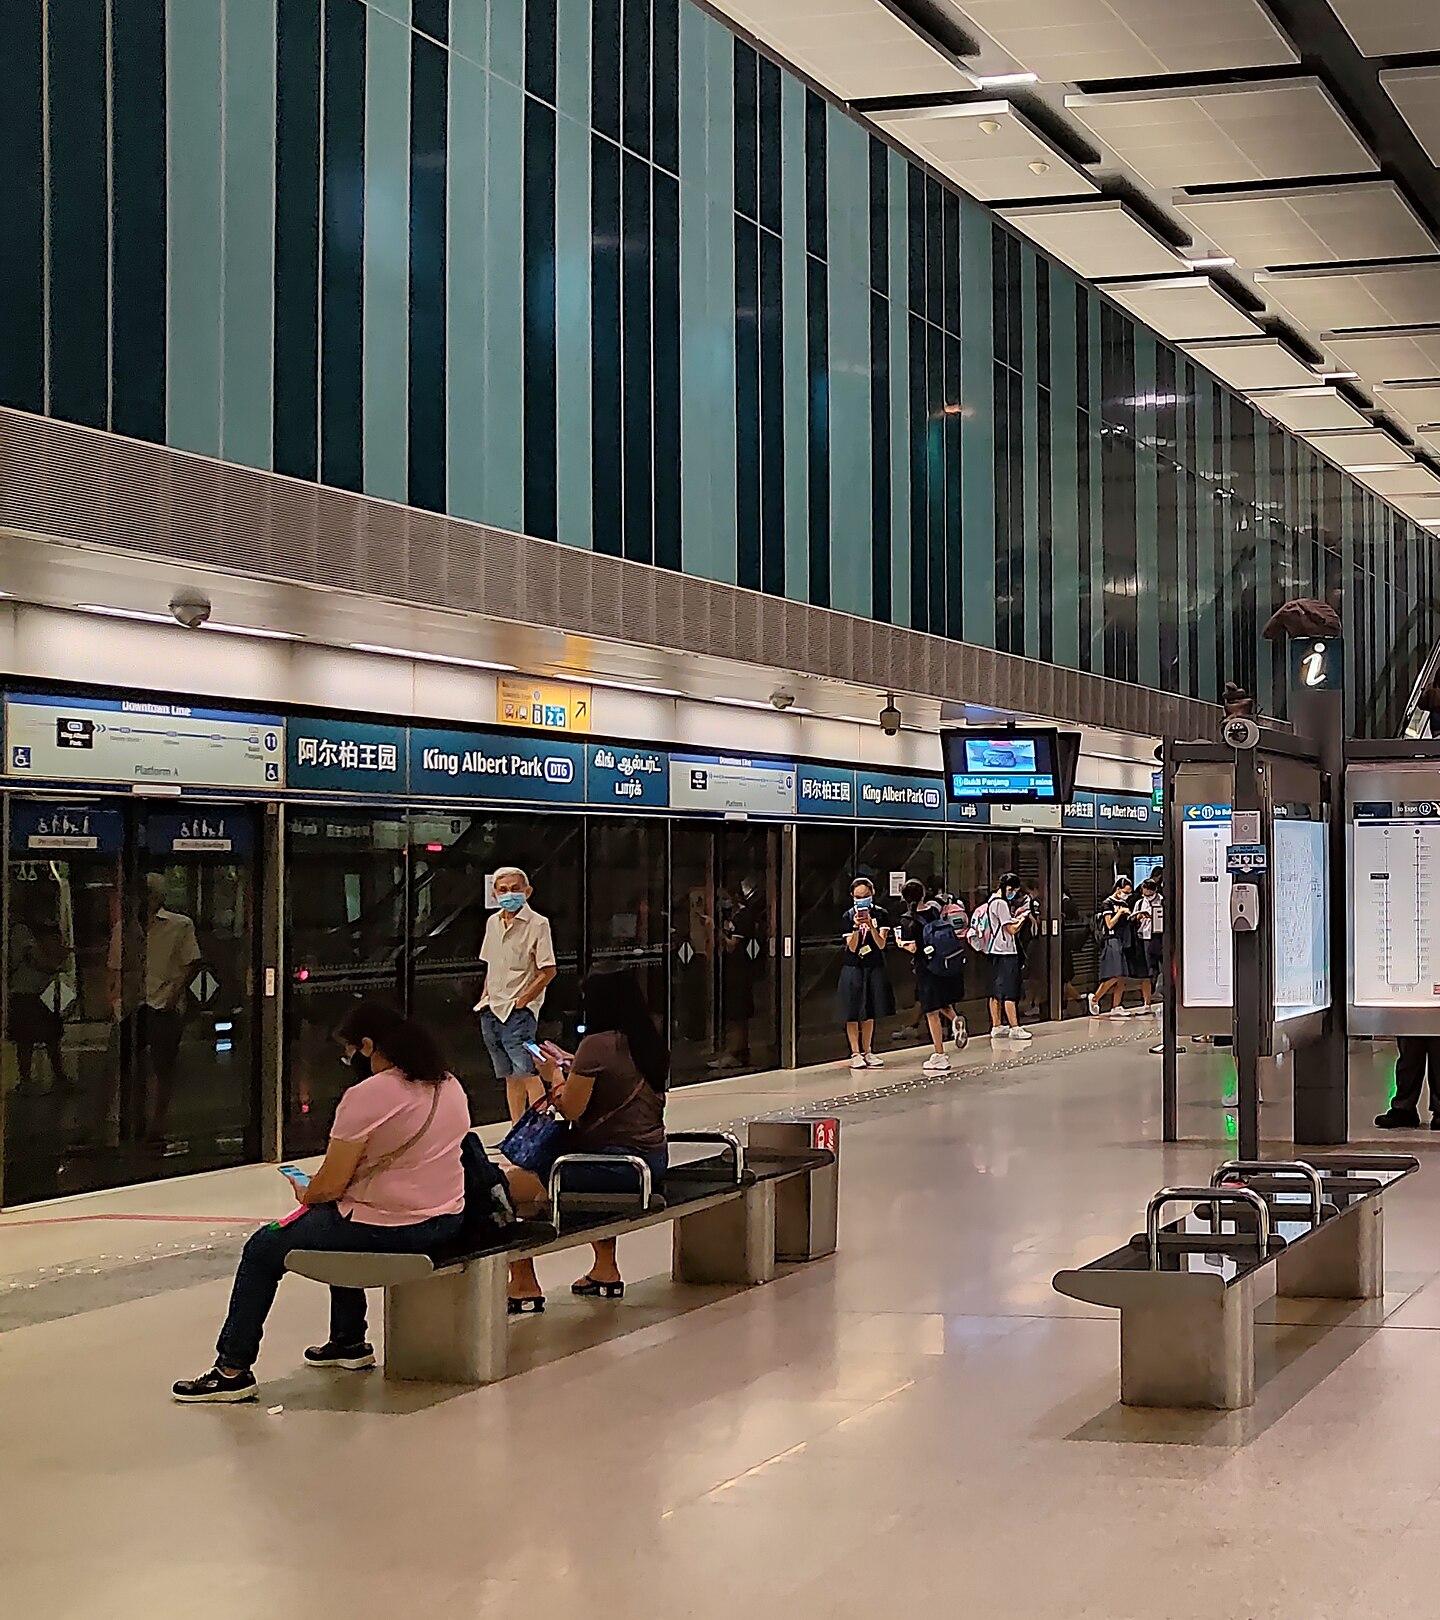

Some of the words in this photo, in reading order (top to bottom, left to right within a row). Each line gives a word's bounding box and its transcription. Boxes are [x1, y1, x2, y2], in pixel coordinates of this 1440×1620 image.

[122, 700, 170, 714] Downtown
[171, 705, 192, 717] Line
[265, 735, 276, 748] 11
[298, 737, 397, 771] 阿尔柏王园
[423, 748, 459, 775] King
[462, 751, 508, 774] Albert
[511, 755, 543, 777] Park
[550, 763, 568, 777] DT6
[134, 764, 171, 776] Platform
[173, 767, 179, 776] A
[615, 778, 642, 798] பார்க்
[802, 779, 850, 801] 阿尔柏王园
[862, 784, 881, 804] King
[882, 786, 905, 802] Albert
[906, 788, 923, 804] Park
[1099, 803, 1112, 819] King
[1112, 804, 1126, 818] Albert
[1126, 806, 1137, 818] Park
[1204, 808, 1211, 817] 11
[1404, 805, 1418, 813] Expo
[1421, 805, 1429, 813] 12
